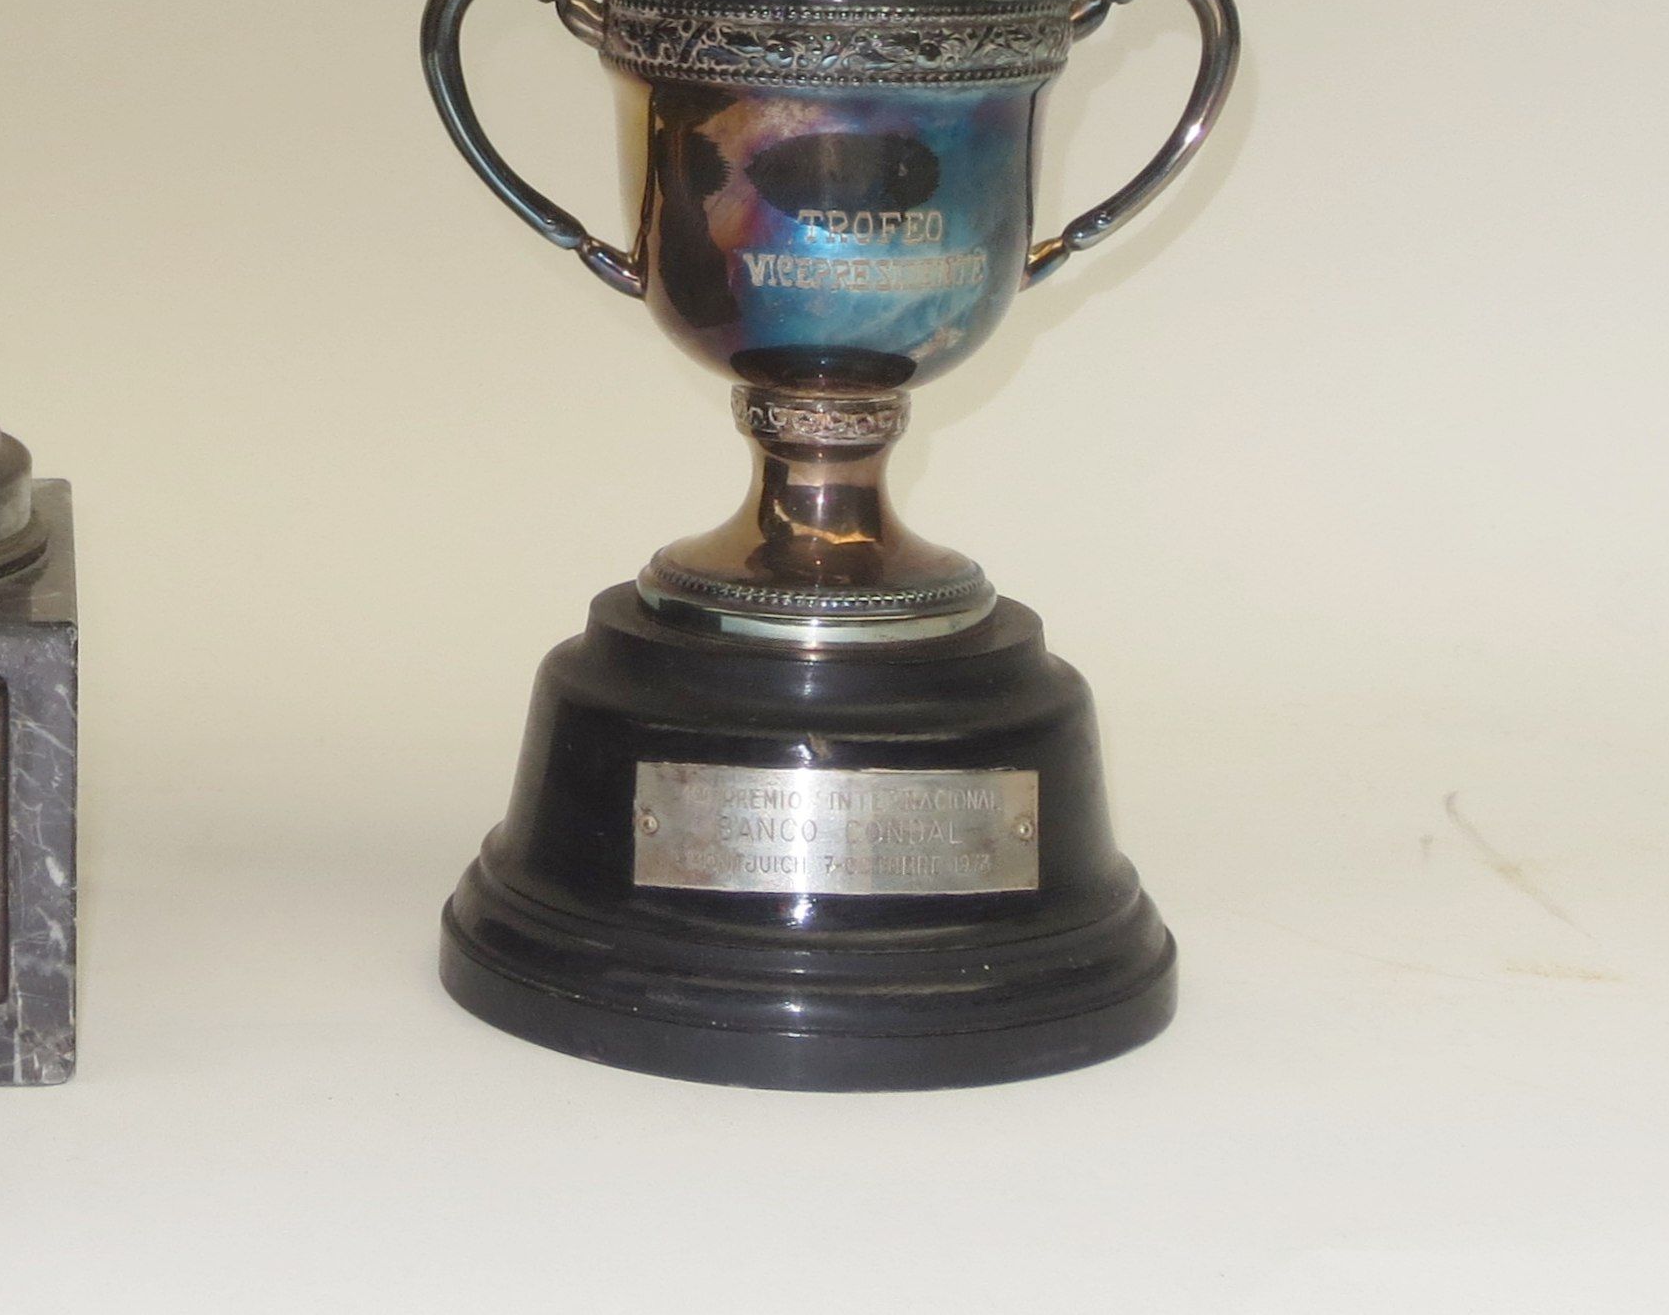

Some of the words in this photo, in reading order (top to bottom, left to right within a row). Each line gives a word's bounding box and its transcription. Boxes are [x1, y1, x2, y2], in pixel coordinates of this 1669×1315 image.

[798, 208, 943, 245] TROFEO
[742, 252, 987, 292] VICEPRESNTE
[723, 788, 802, 811] PREMIO
[719, 815, 818, 843] BANCO
[845, 819, 963, 845] CONDAL
